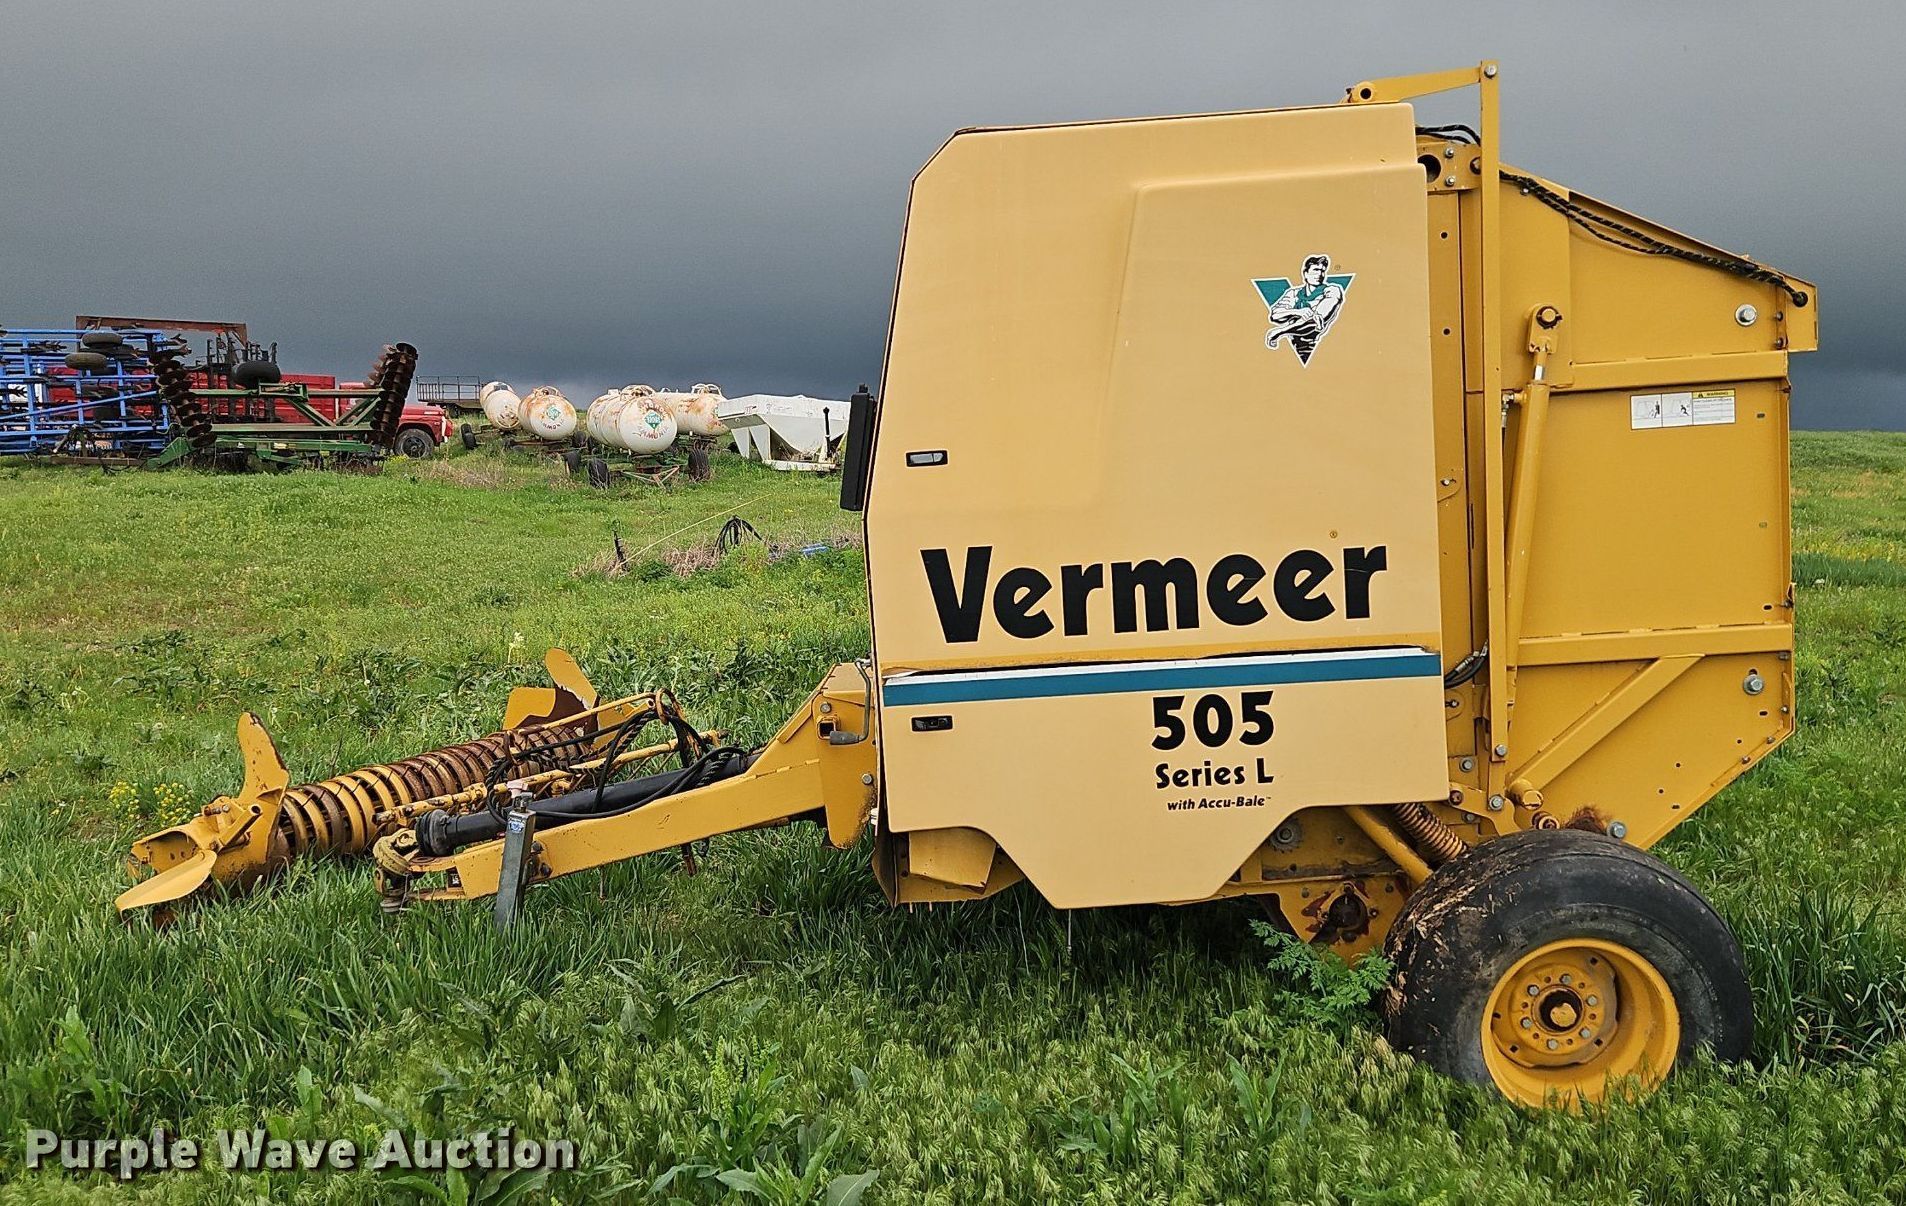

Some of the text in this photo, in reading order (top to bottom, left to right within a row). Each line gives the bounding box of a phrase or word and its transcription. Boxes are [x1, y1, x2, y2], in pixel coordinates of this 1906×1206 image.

[920, 546, 1387, 643] Vermeer
[1151, 691, 1274, 750] 505
[1155, 757, 1274, 789] Series L
[1167, 798, 1195, 811] with
